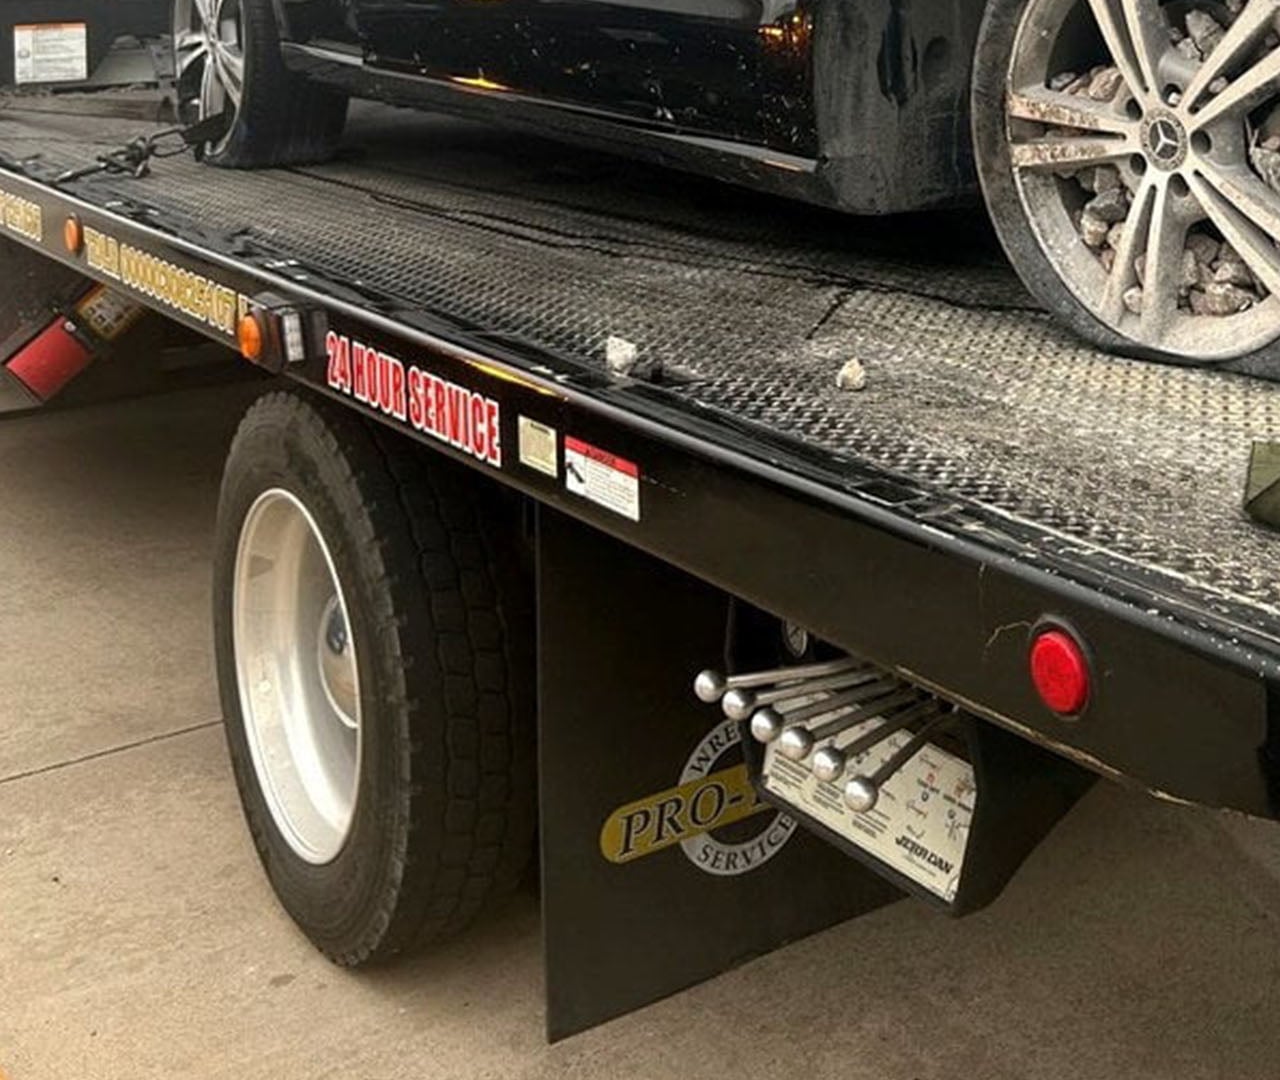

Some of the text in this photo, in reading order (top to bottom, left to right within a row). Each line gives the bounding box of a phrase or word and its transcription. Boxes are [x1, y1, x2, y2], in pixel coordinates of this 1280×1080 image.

[326, 331, 351, 394] 24
[353, 342, 406, 421] HOUR
[407, 367, 501, 468] SERVICE
[619, 784, 761, 858] PRO-
[697, 815, 794, 870] SERVICE
